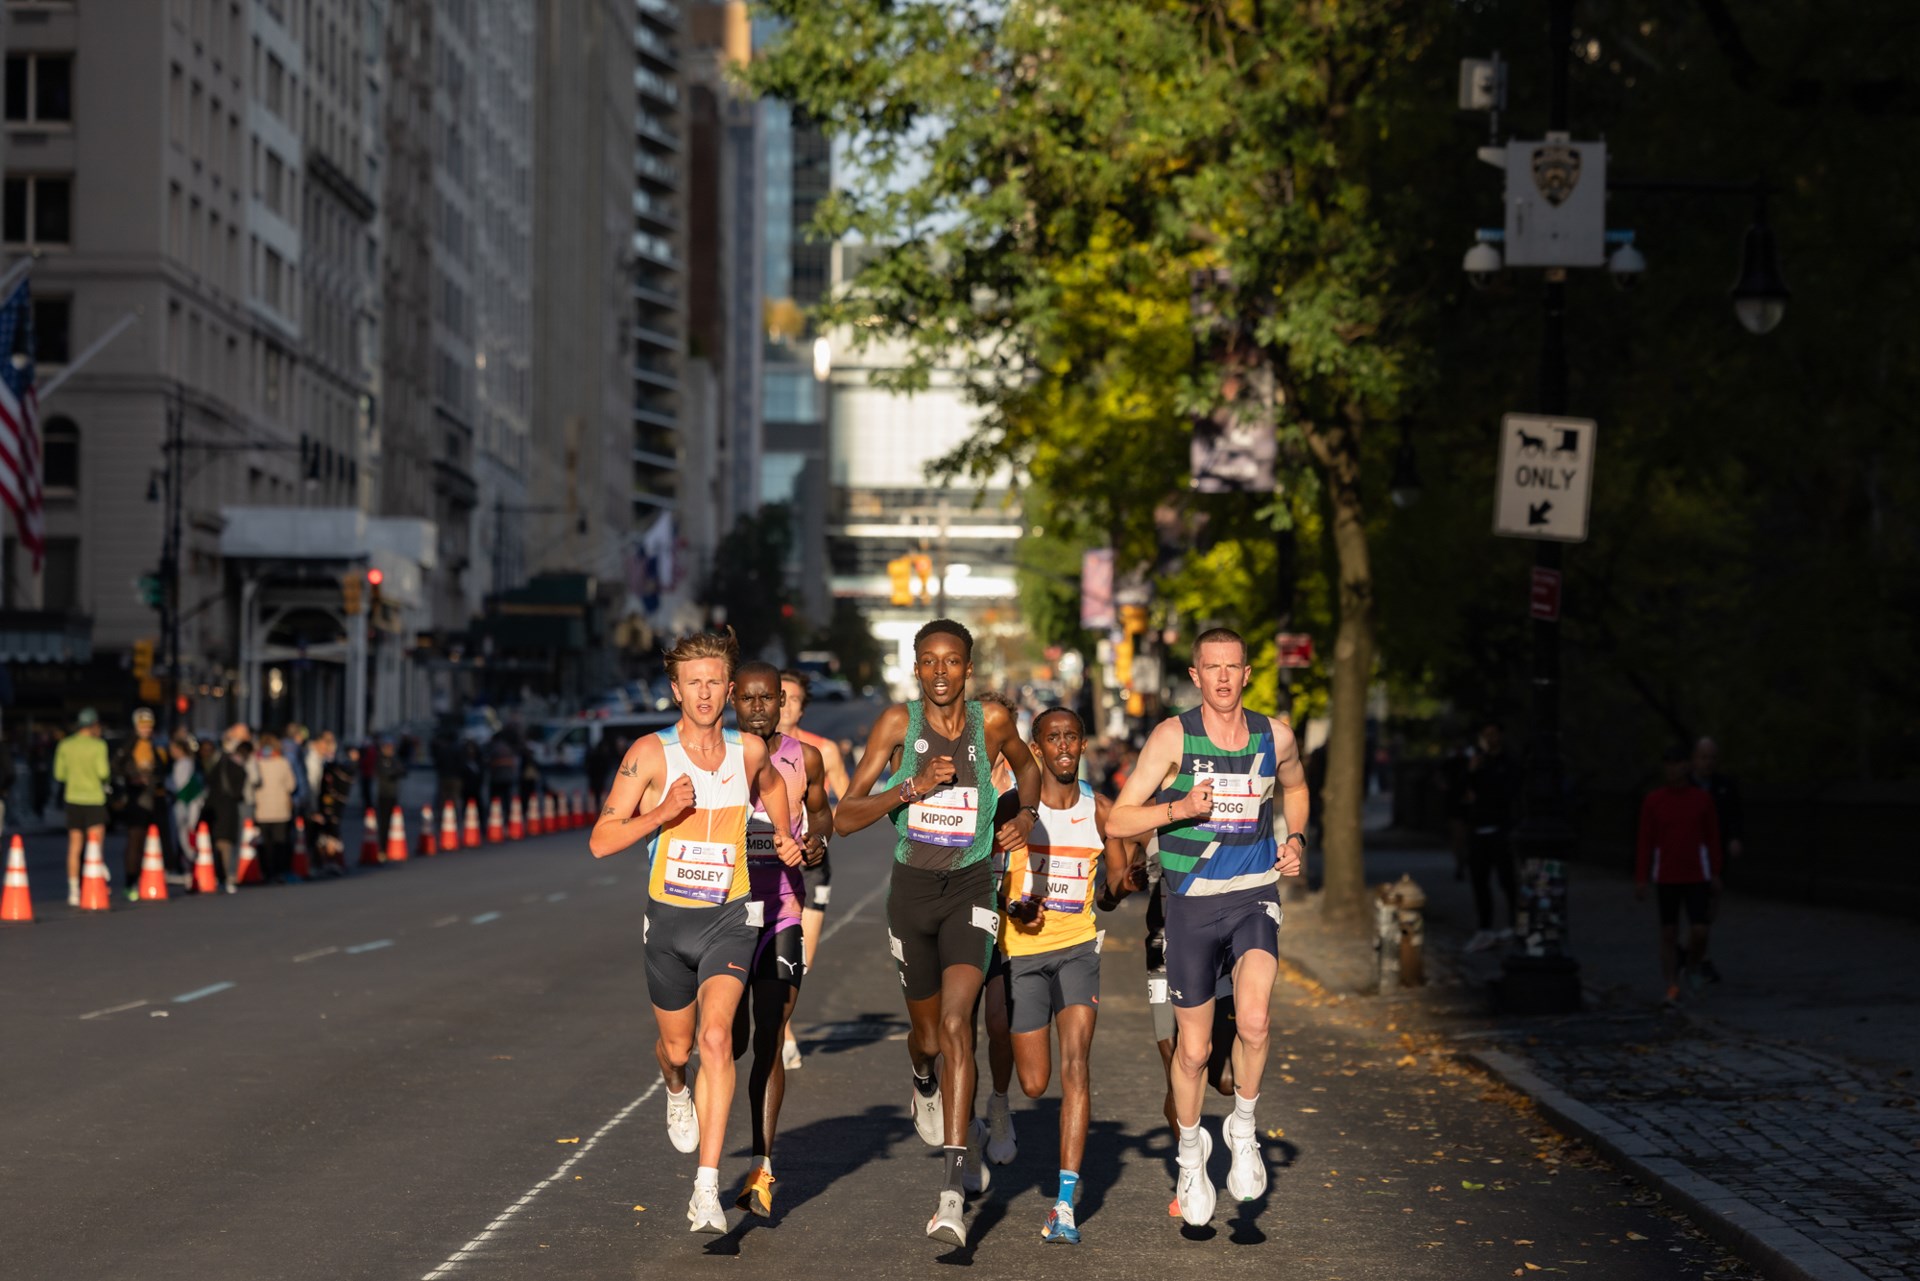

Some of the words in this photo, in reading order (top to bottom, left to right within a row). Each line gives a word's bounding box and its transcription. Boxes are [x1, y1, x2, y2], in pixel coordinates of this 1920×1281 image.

[1516, 465, 1576, 491] ONLY
[920, 811, 963, 827] KIPROP
[677, 867, 724, 883] BOSLEY
[1045, 881, 1069, 895] NUR
[991, 916, 999, 931] 3
